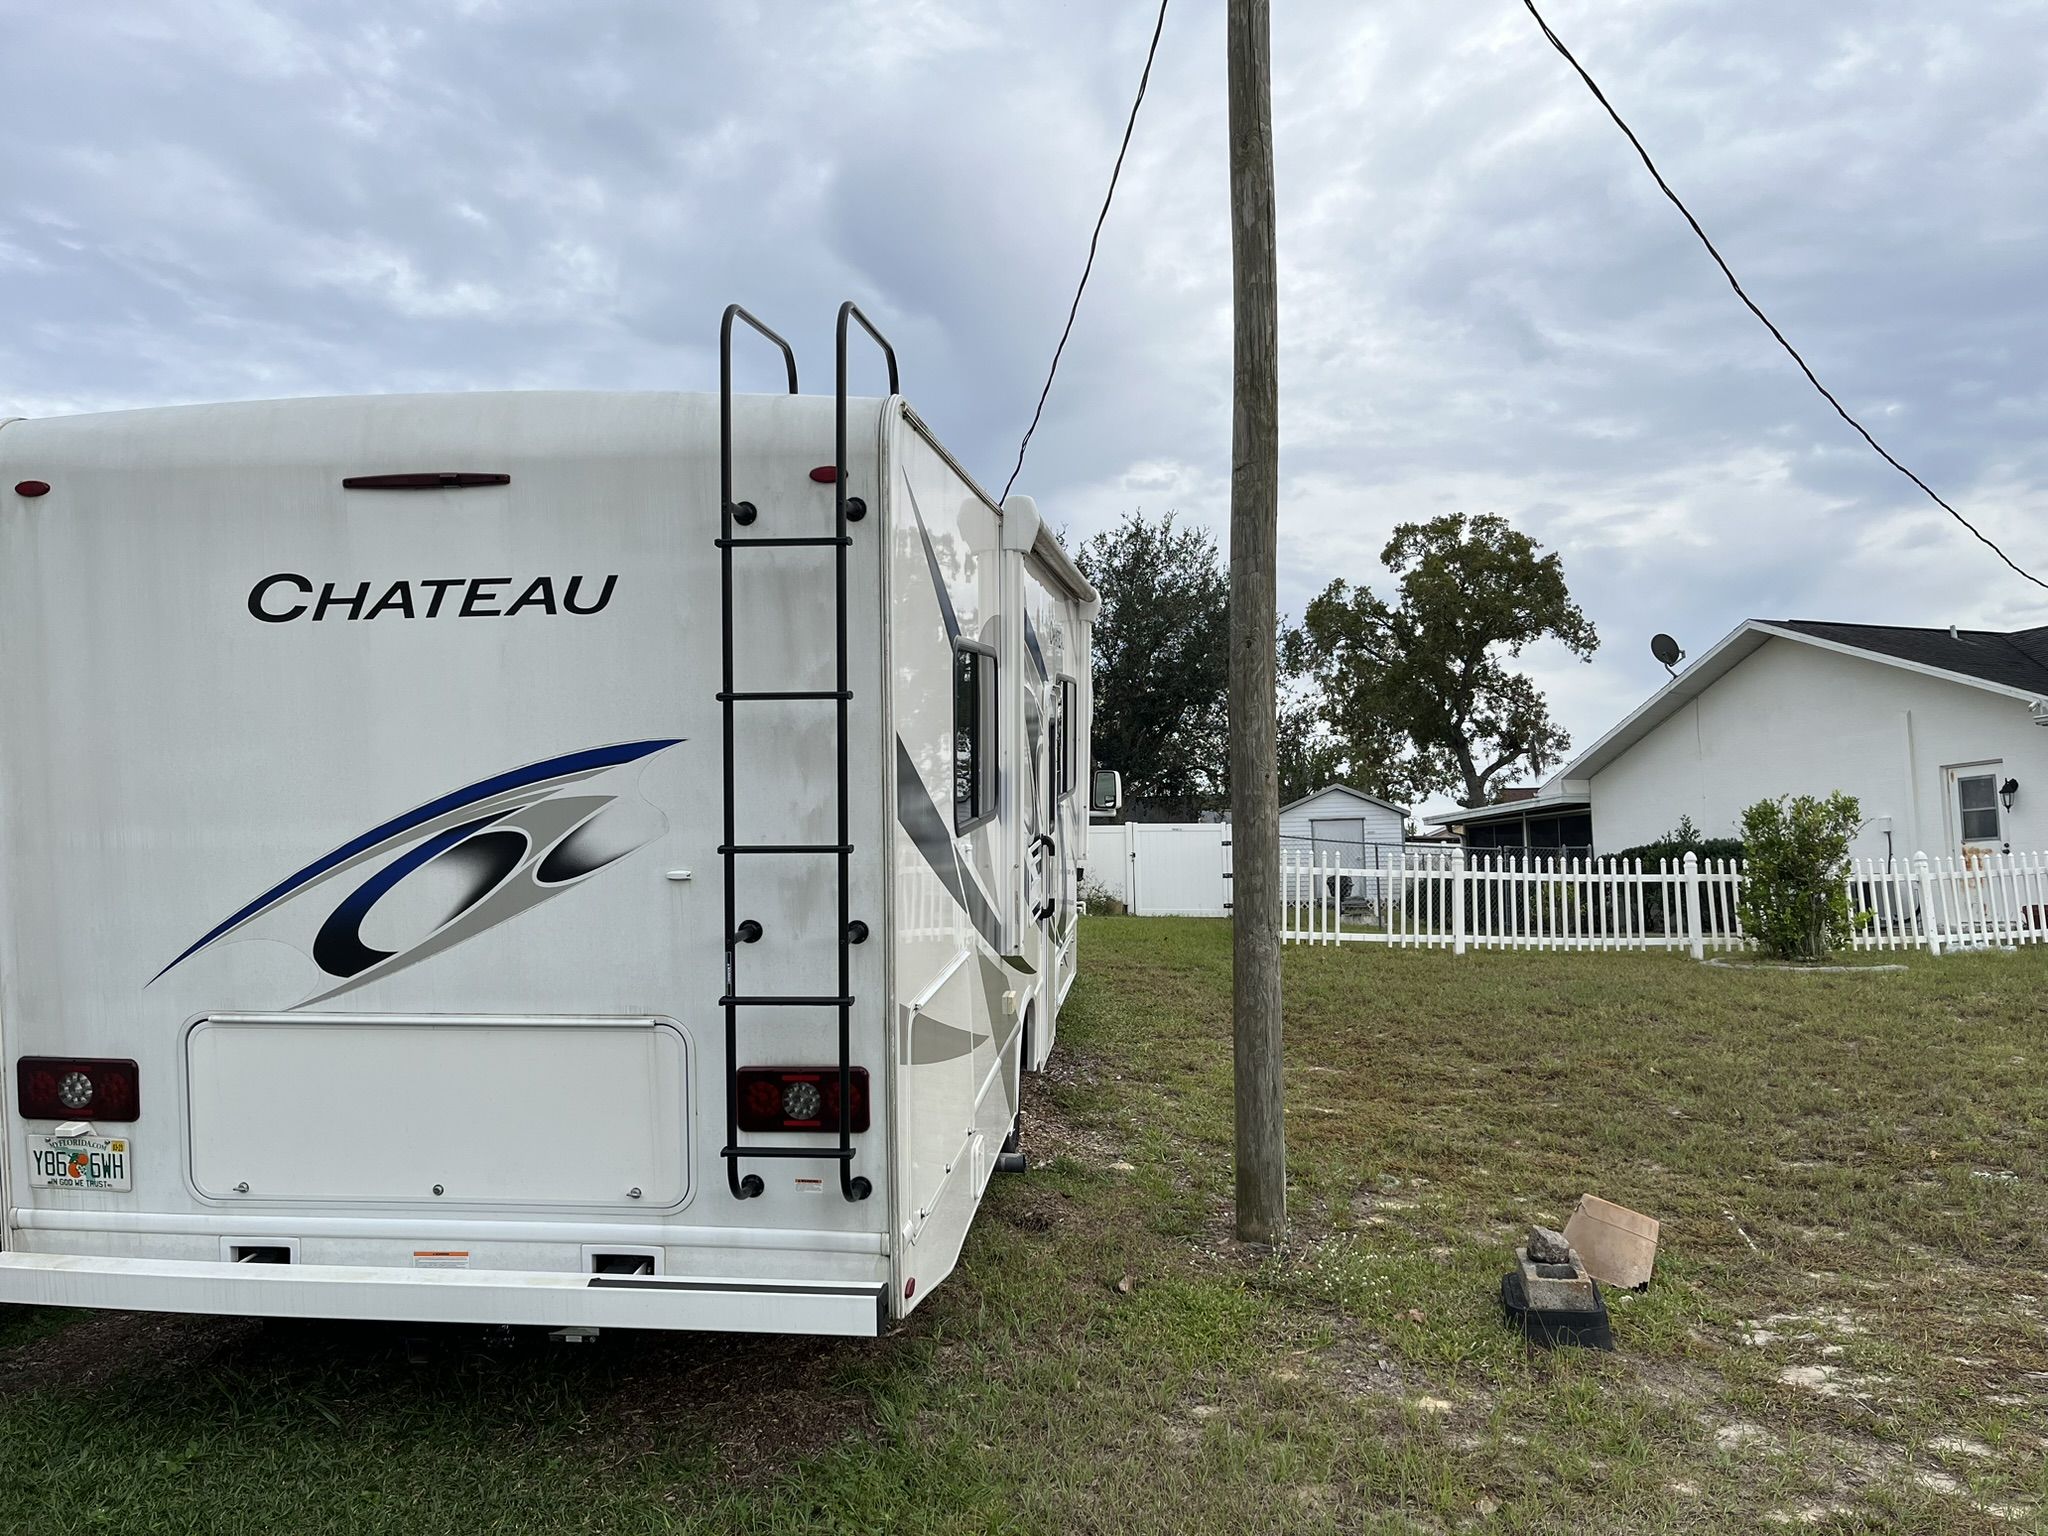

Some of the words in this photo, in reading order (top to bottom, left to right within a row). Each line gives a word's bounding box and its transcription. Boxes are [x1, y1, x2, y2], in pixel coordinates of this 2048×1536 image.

[247, 572, 619, 623] CHATEAU
[33, 1150, 67, 1177] Y86
[90, 1153, 124, 1179] 6WH
[59, 1178, 74, 1186] GOD
[74, 1179, 84, 1187] WE
[86, 1179, 107, 1188] TRUST
